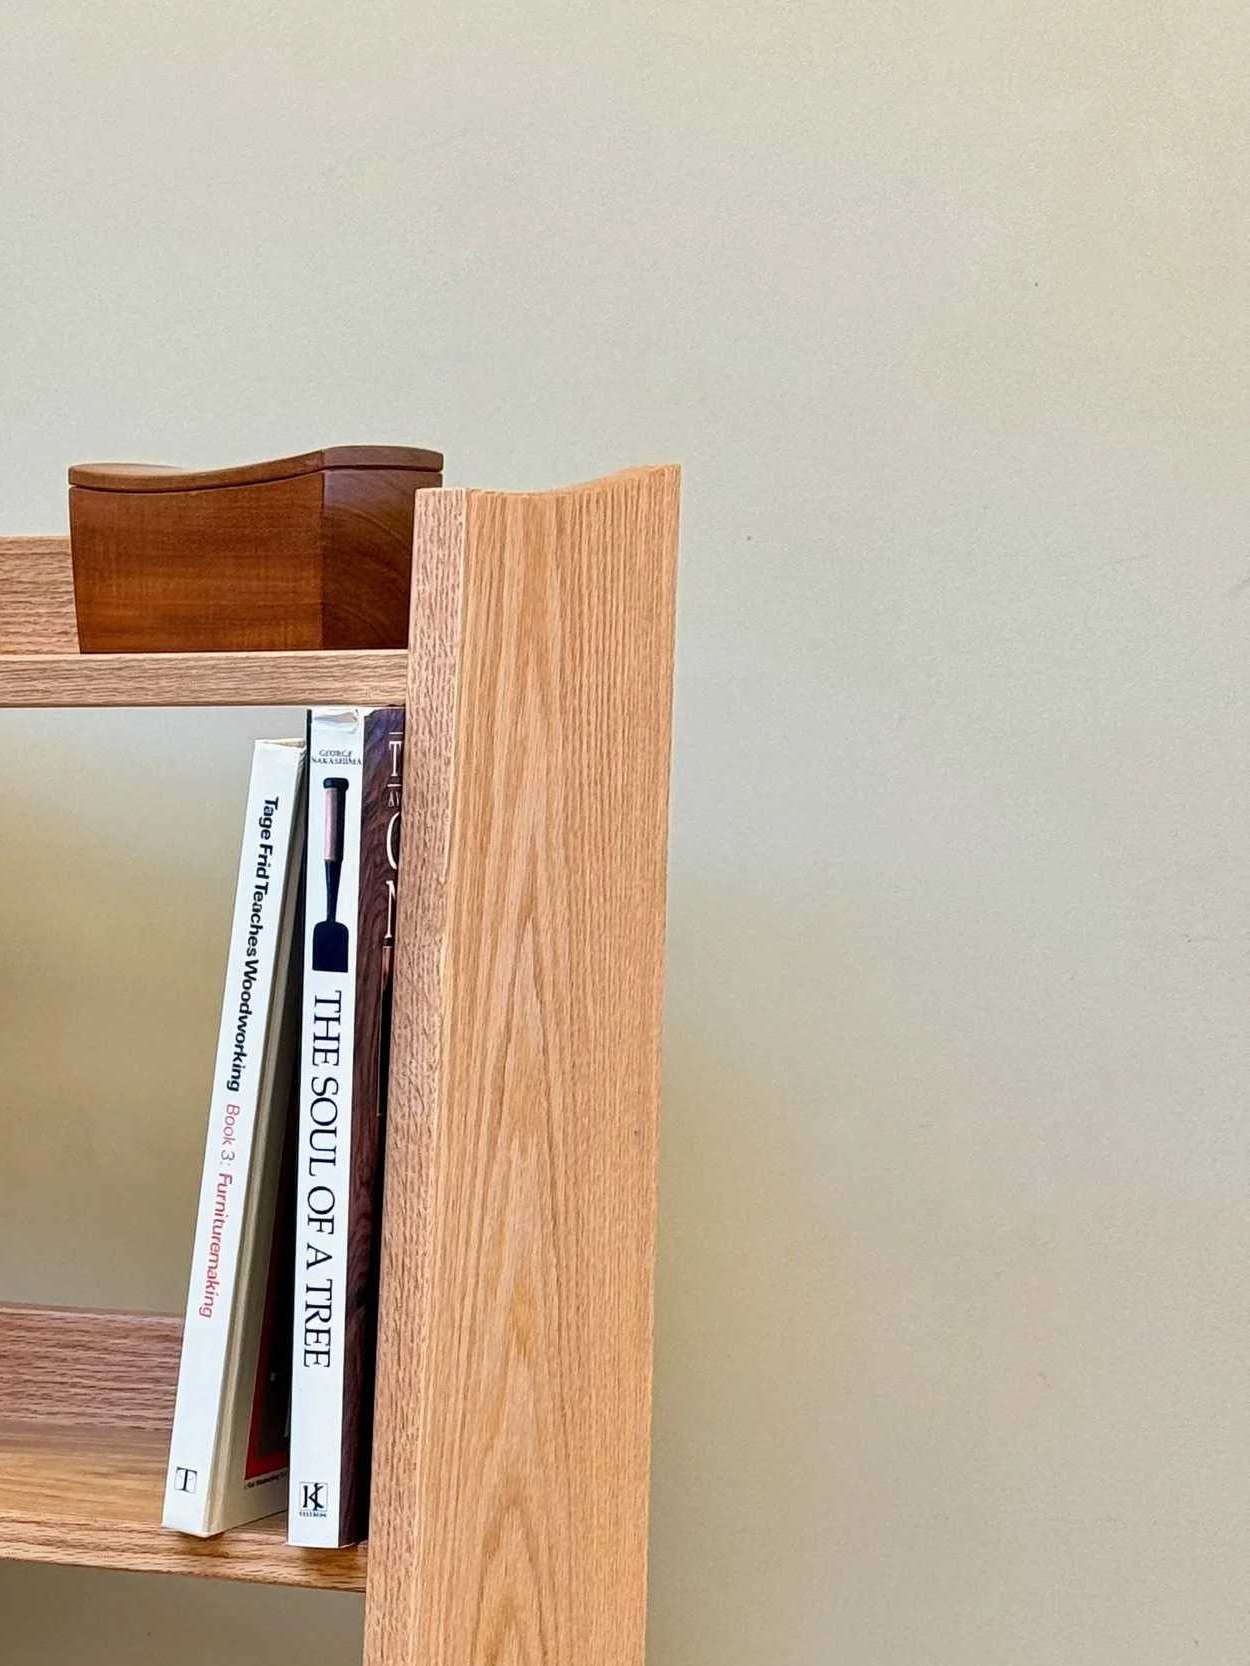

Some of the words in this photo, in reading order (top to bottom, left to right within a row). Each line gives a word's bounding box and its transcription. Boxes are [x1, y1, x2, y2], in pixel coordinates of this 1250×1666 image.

[259, 797, 279, 840] Tage
[254, 843, 273, 879] Frid
[246, 881, 269, 957] Teaches
[226, 958, 260, 1092] Woodworking
[312, 990, 342, 1067] THE
[221, 1103, 240, 1146] Book
[308, 1076, 339, 1177] SOUL
[219, 1149, 235, 1166] 3:
[306, 1185, 336, 1235] OF
[199, 1172, 233, 1318] Furnituremaking
[306, 1243, 333, 1270] A
[303, 1278, 333, 1368] TREE
